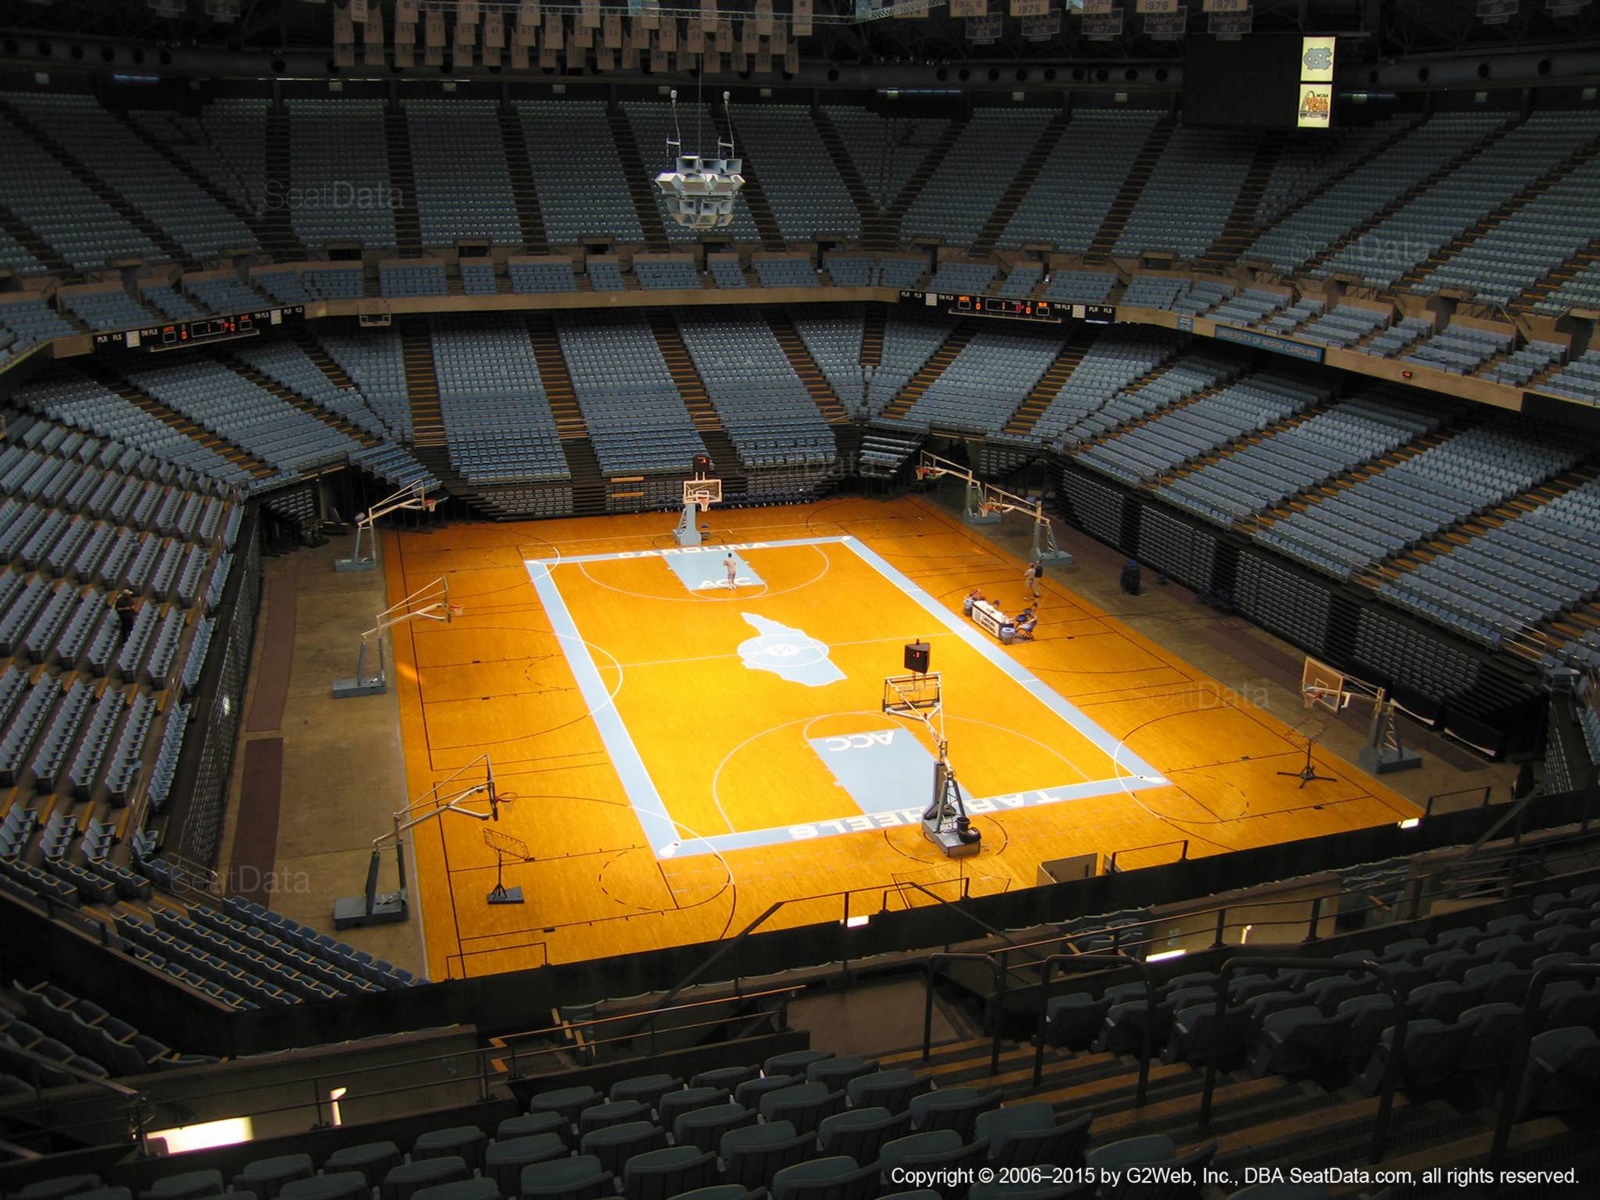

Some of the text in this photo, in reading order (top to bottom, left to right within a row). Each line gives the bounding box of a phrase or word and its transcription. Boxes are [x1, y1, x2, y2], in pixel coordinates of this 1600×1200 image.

[1018, 4, 1041, 14] 1976
[1145, 1, 1169, 10] 1978
[1212, 0, 1239, 9] 1979
[1285, 344, 1317, 358] CAROLINA
[618, 542, 773, 558] CAROLINA
[698, 577, 752, 589] ACC
[825, 730, 897, 752] ACC
[788, 790, 1061, 840] TAR HEELS
